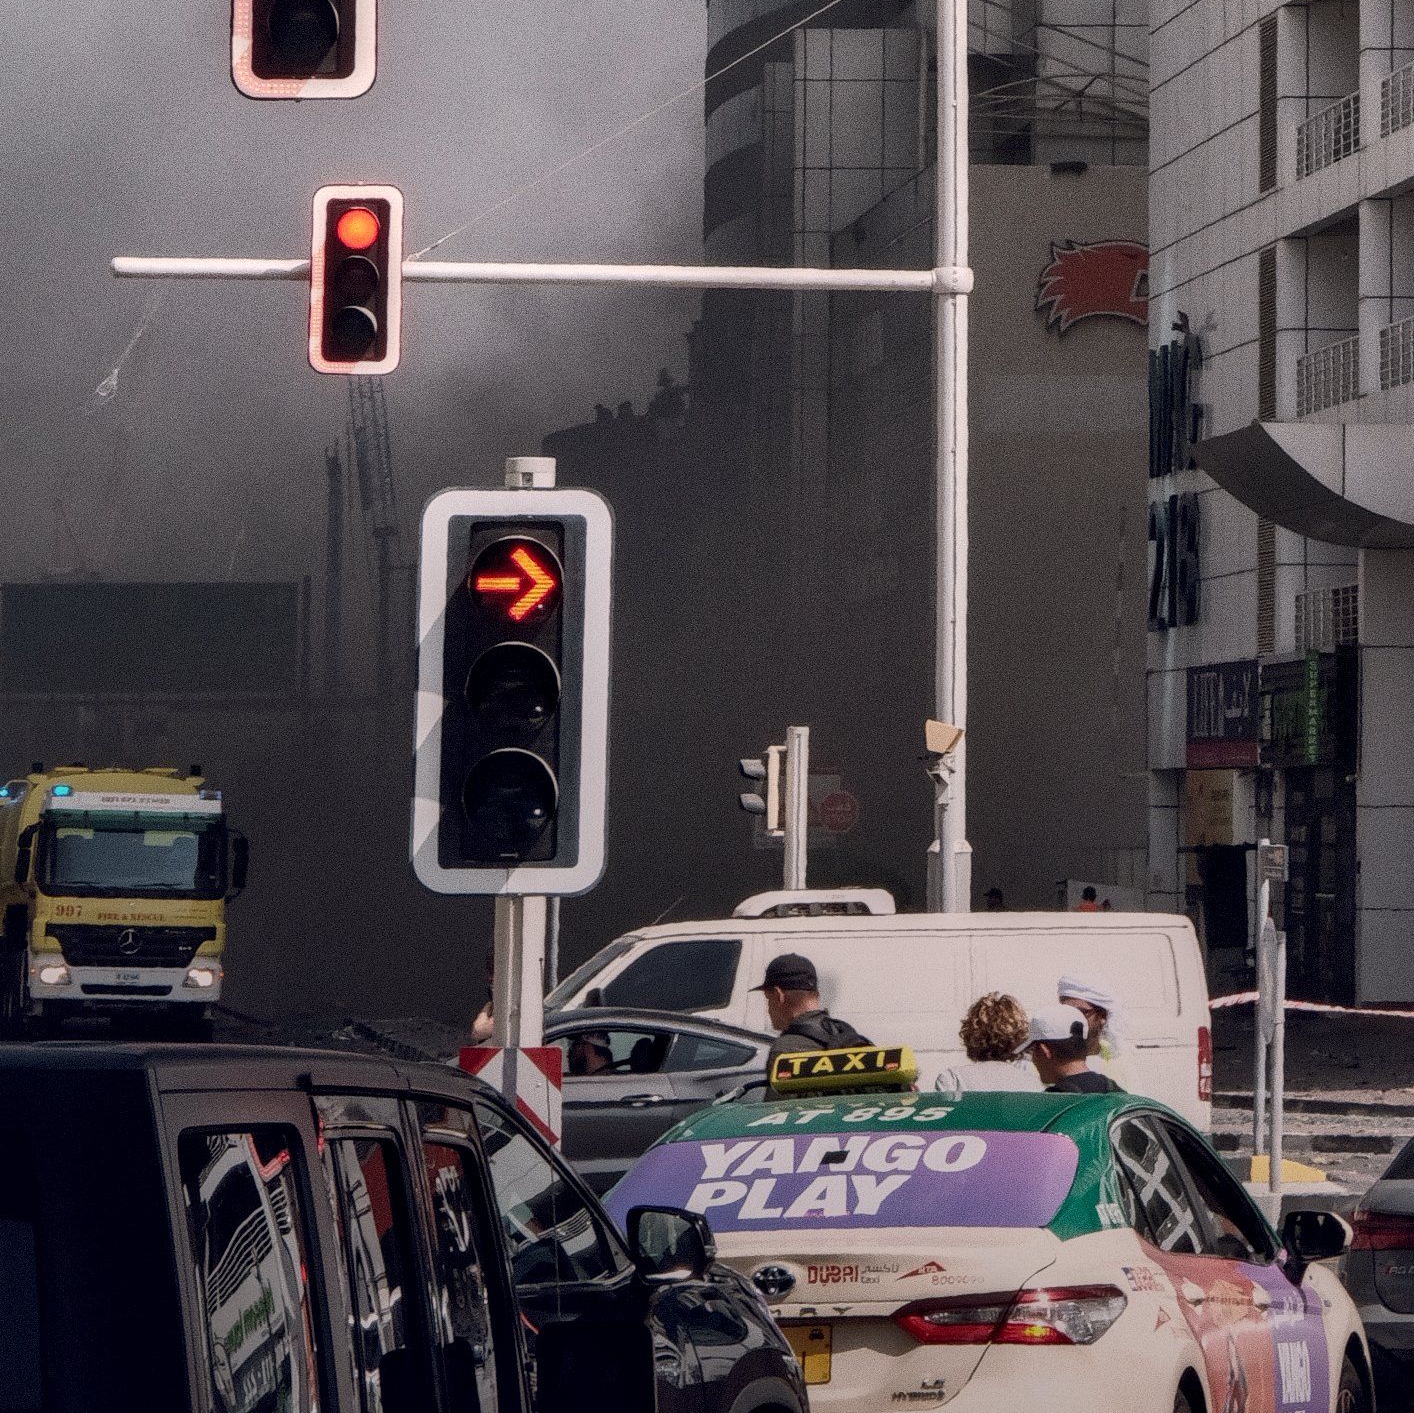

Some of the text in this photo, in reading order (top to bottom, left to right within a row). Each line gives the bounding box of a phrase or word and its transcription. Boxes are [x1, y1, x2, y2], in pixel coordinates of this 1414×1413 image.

[55, 905, 82, 917] 997
[788, 1051, 886, 1075] TAXI
[746, 1106, 954, 1126] AT 895
[700, 1135, 988, 1180] YANGO
[684, 1174, 911, 1220] PLAY
[808, 1265, 859, 1286] DUBAI
[861, 1275, 880, 1284] taxi
